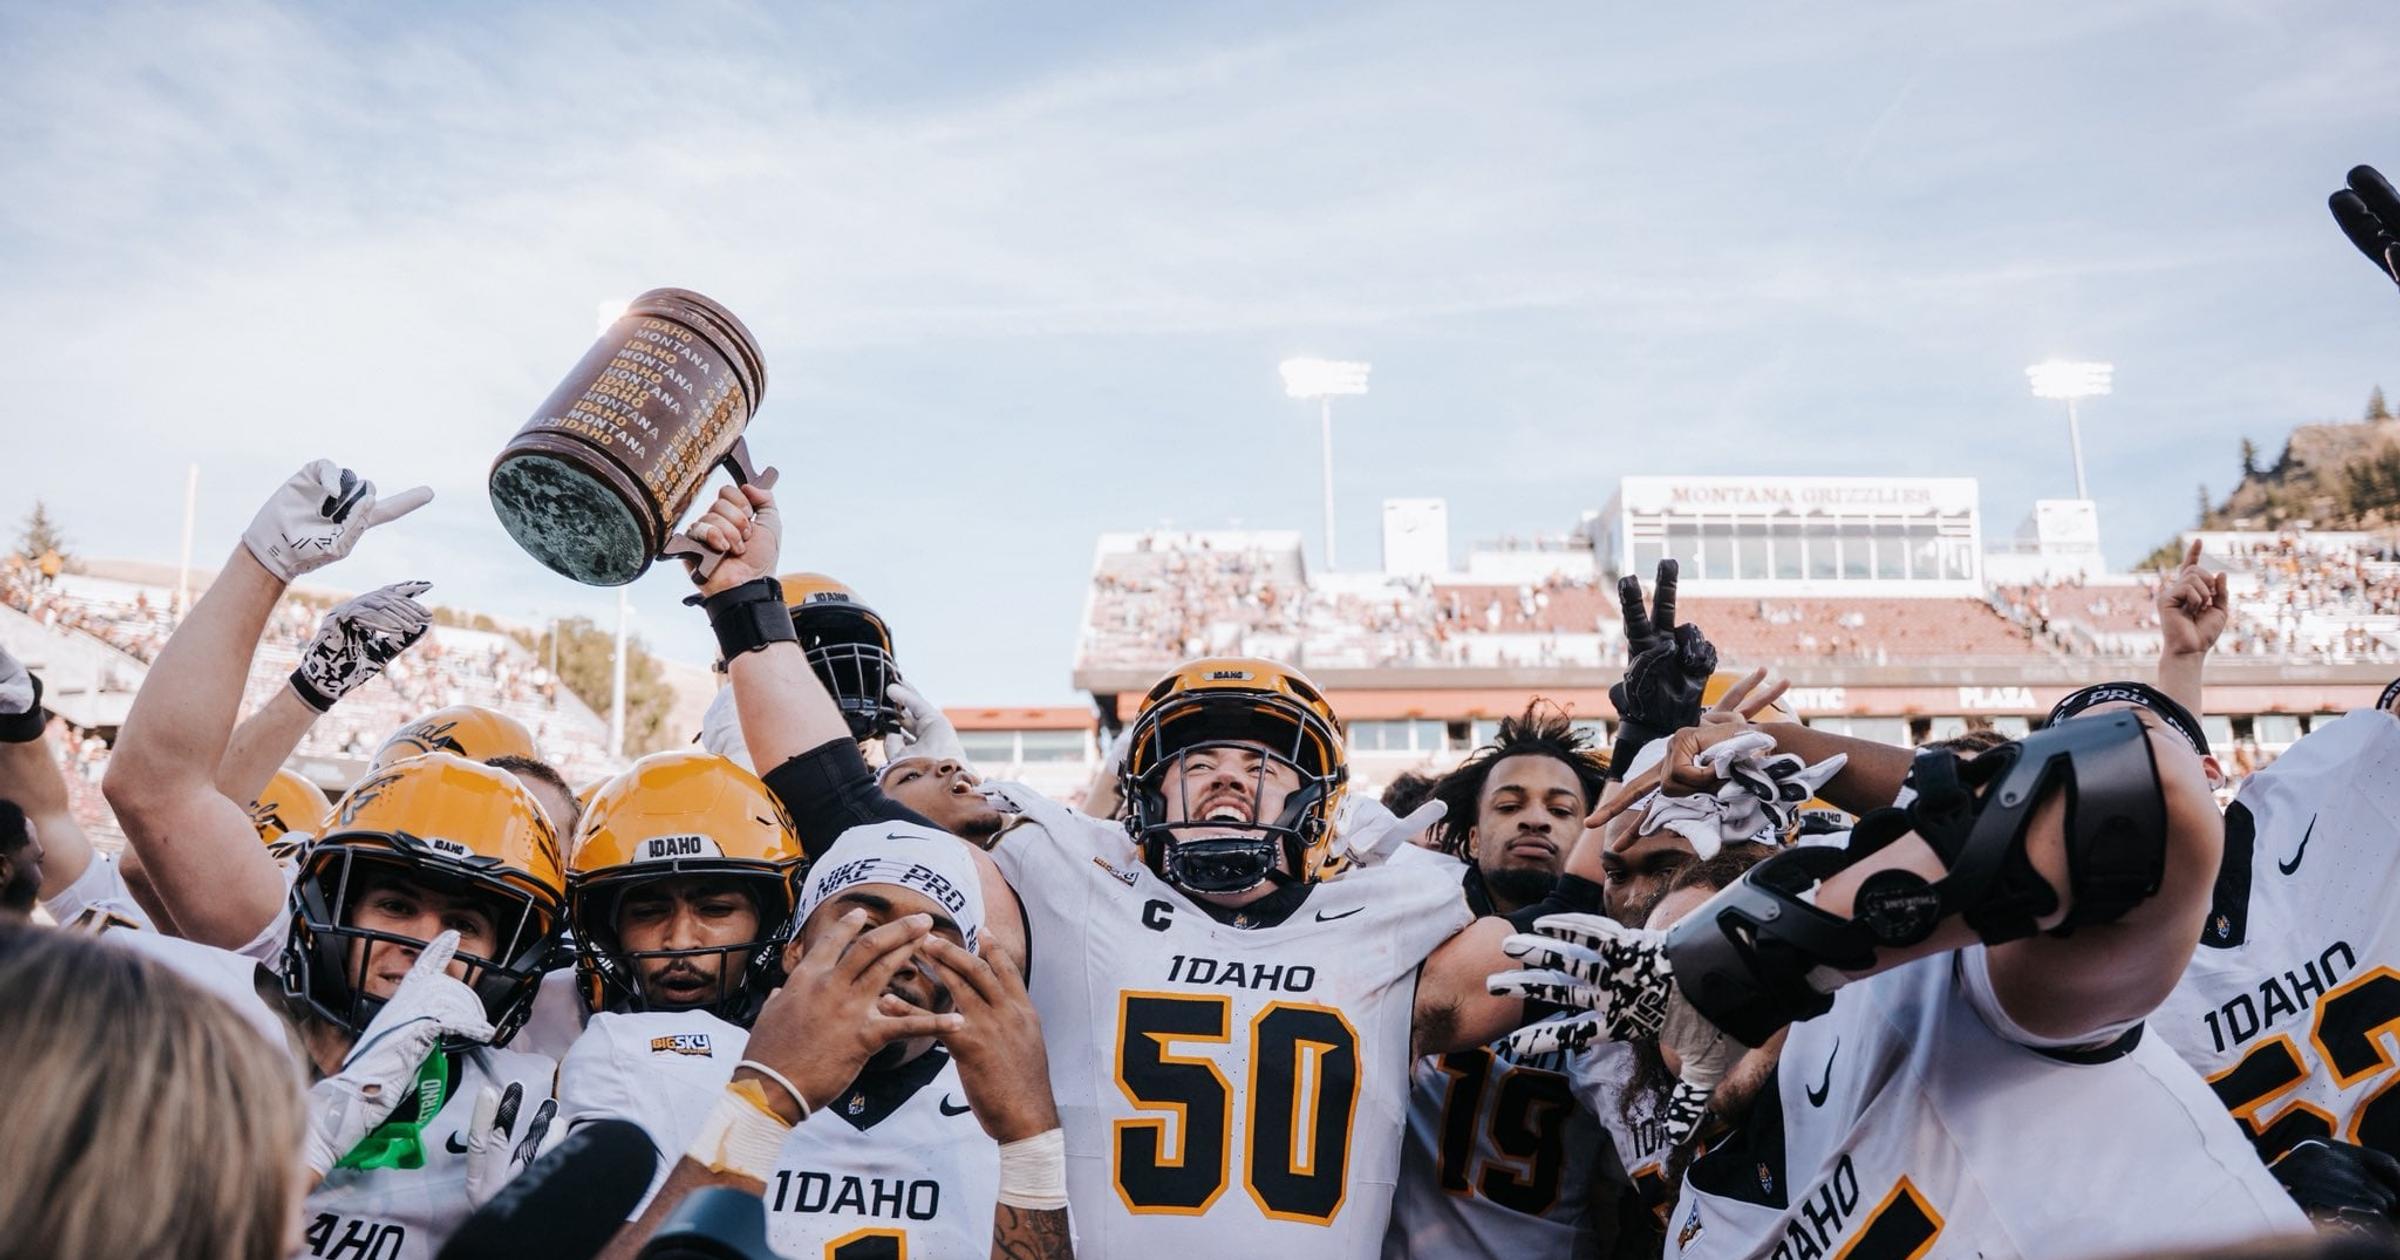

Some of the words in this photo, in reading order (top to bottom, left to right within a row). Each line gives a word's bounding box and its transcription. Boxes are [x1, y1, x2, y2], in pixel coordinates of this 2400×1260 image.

[641, 320, 692, 343] IDAHO
[624, 339, 678, 364] IDAHO
[634, 329, 710, 375] MONTANA
[597, 374, 650, 400] IDAHO
[609, 358, 663, 384] IDAHO
[617, 349, 693, 395] MONTANA
[589, 382, 644, 408] IDAHO
[604, 366, 681, 415] MONTANA
[574, 400, 627, 427] IDAHO
[582, 391, 660, 441] MONTANA
[558, 418, 613, 445] IDAHO
[567, 409, 646, 459] MONTANA
[1671, 487, 1796, 503] MONTANA
[1801, 487, 1932, 504] GRIZZLIES
[1213, 671, 1243, 680] IDAHO
[1958, 687, 2037, 708] PLAZA
[433, 839, 465, 855] IDAHO
[648, 836, 701, 857] IDAHO
[815, 858, 881, 905] NIKE
[901, 864, 966, 913] PRO
[1141, 899, 1175, 932] C
[1168, 955, 1315, 992] IDAHO
[2204, 941, 2356, 1053] IDAHO
[1113, 989, 1363, 1227] 50
[1436, 1046, 1576, 1217] 19
[773, 1170, 940, 1221] IDAHO
[304, 1212, 405, 1260] AHO
